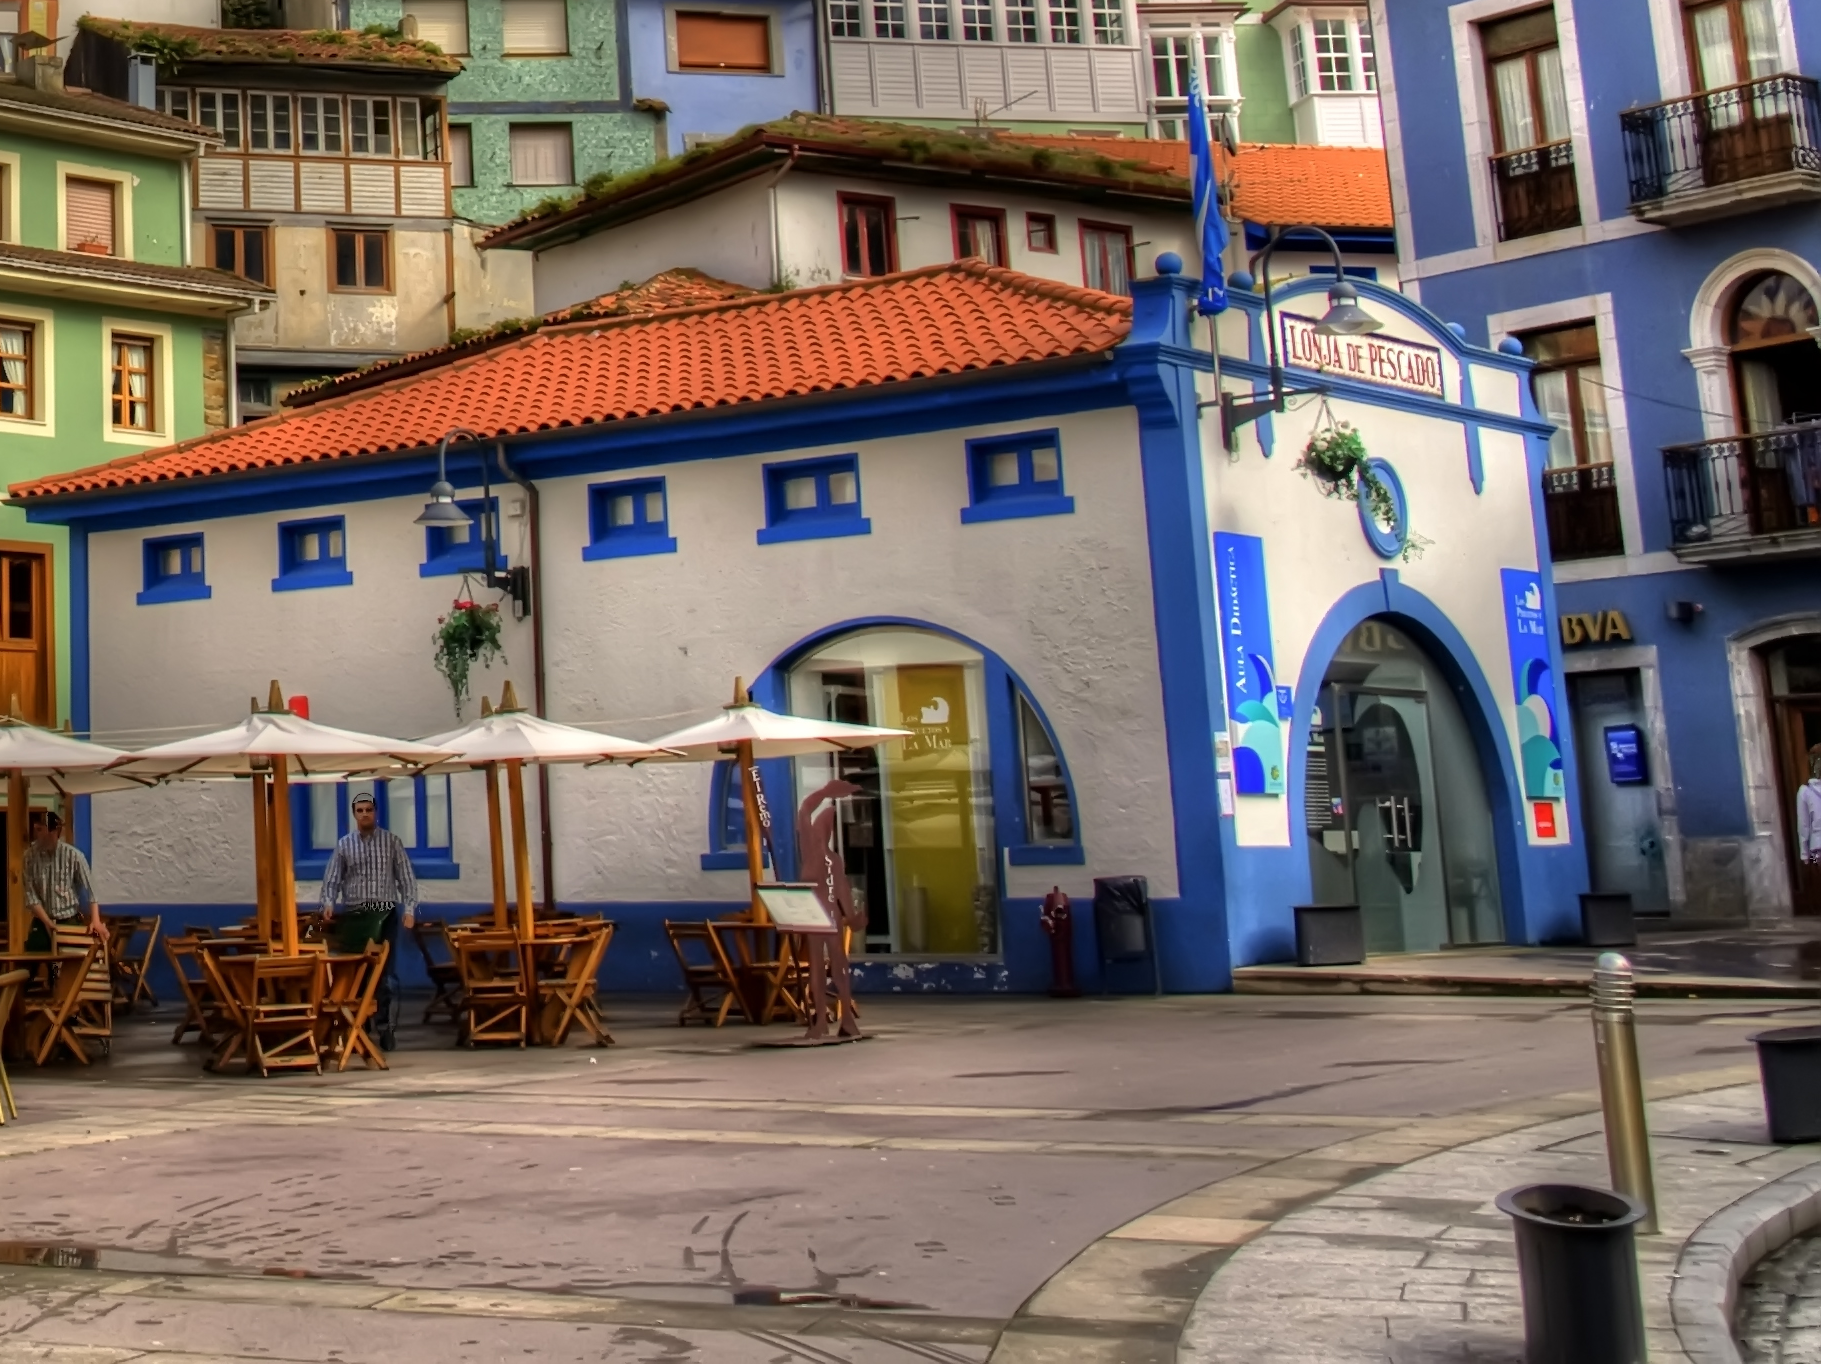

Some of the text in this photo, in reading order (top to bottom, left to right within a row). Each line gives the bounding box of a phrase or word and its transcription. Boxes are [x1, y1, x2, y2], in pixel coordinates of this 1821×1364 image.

[1289, 325, 1436, 388] LONJA DE PESCADO
[1560, 610, 1632, 645] BVA
